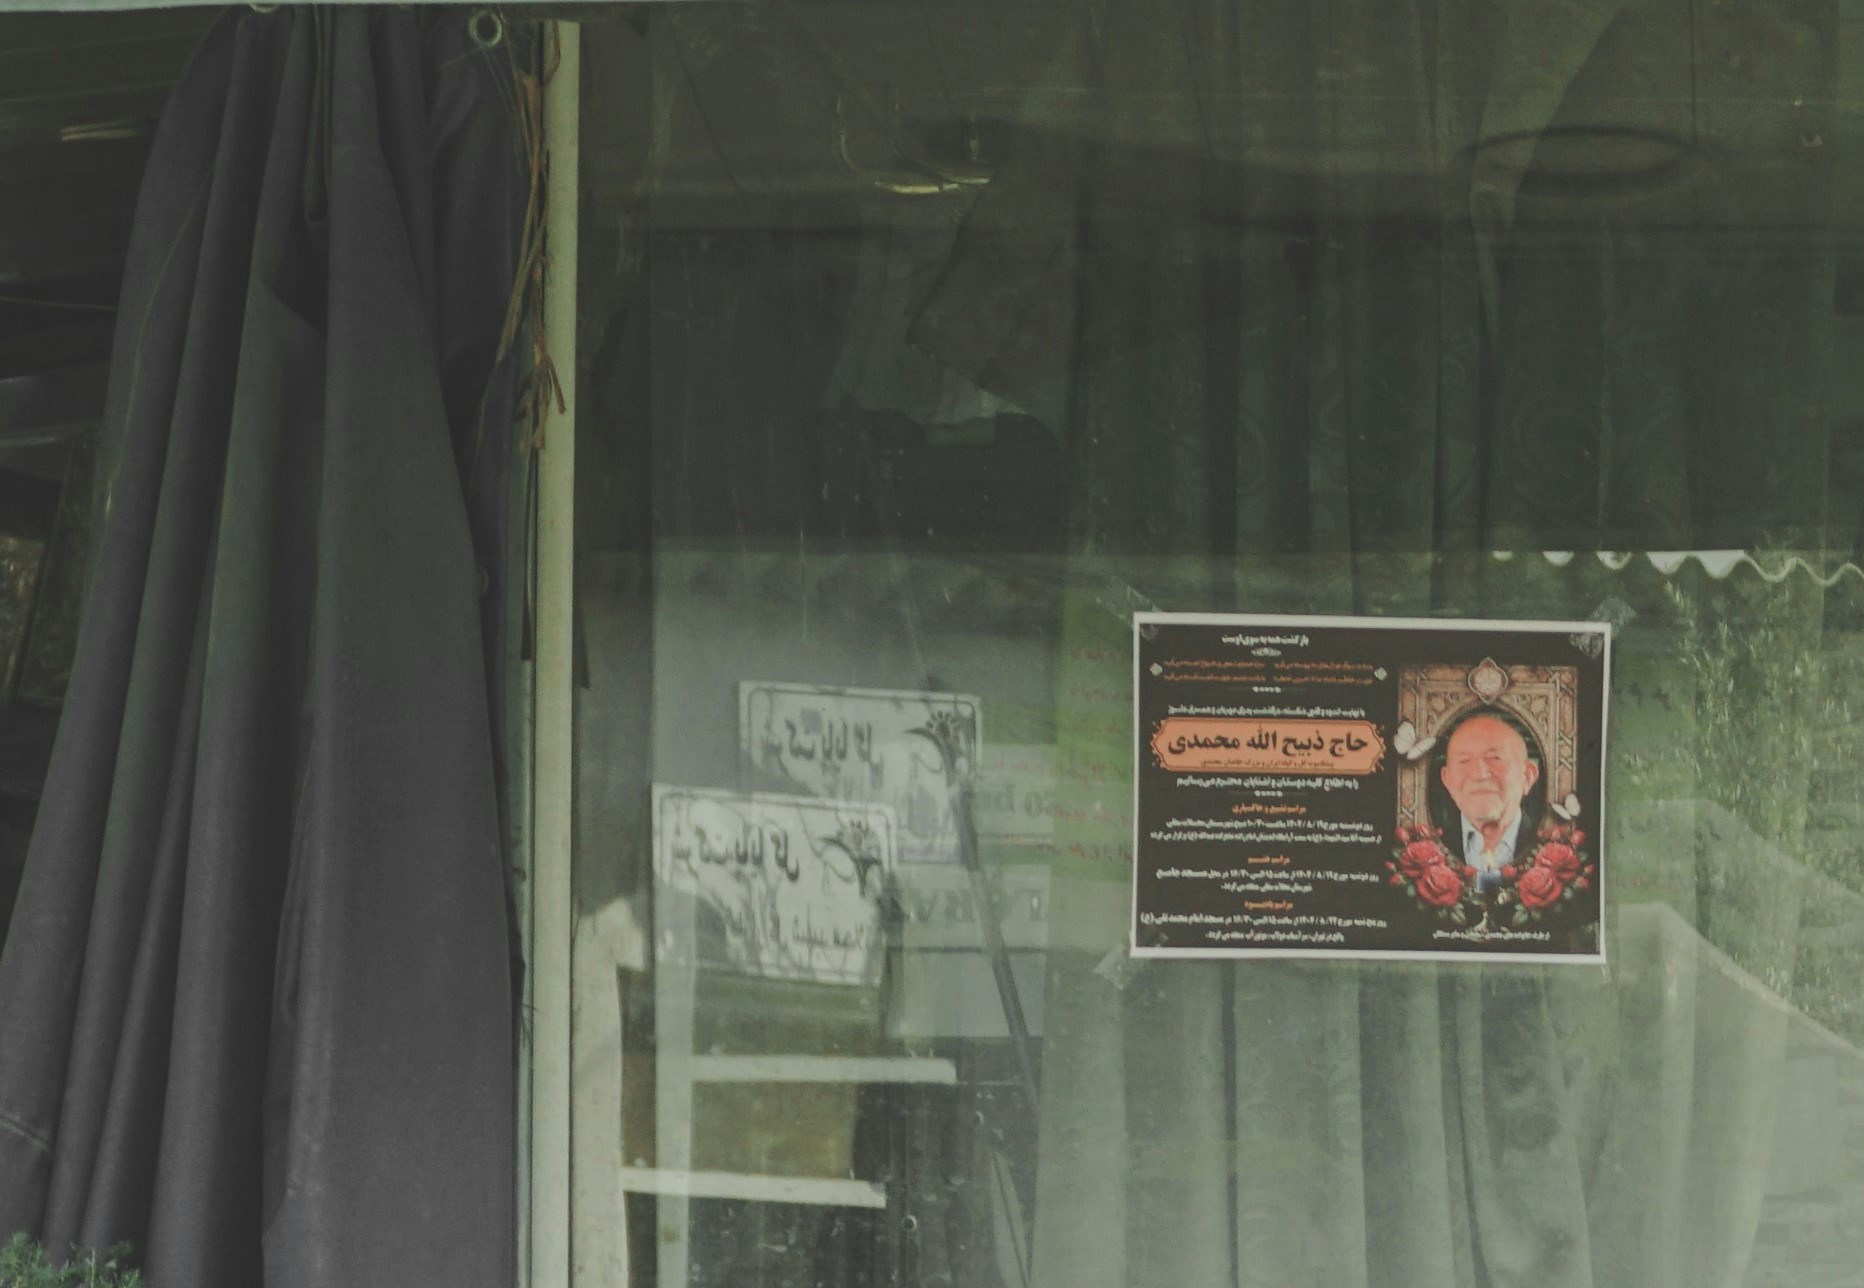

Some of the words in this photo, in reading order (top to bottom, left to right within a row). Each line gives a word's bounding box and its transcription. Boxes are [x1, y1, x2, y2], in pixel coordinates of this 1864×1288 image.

[1168, 733, 1240, 755] محمدی
[1246, 725, 1277, 750] الله
[1282, 729, 1324, 757] ذبیح
[1329, 732, 1368, 757] حاج
